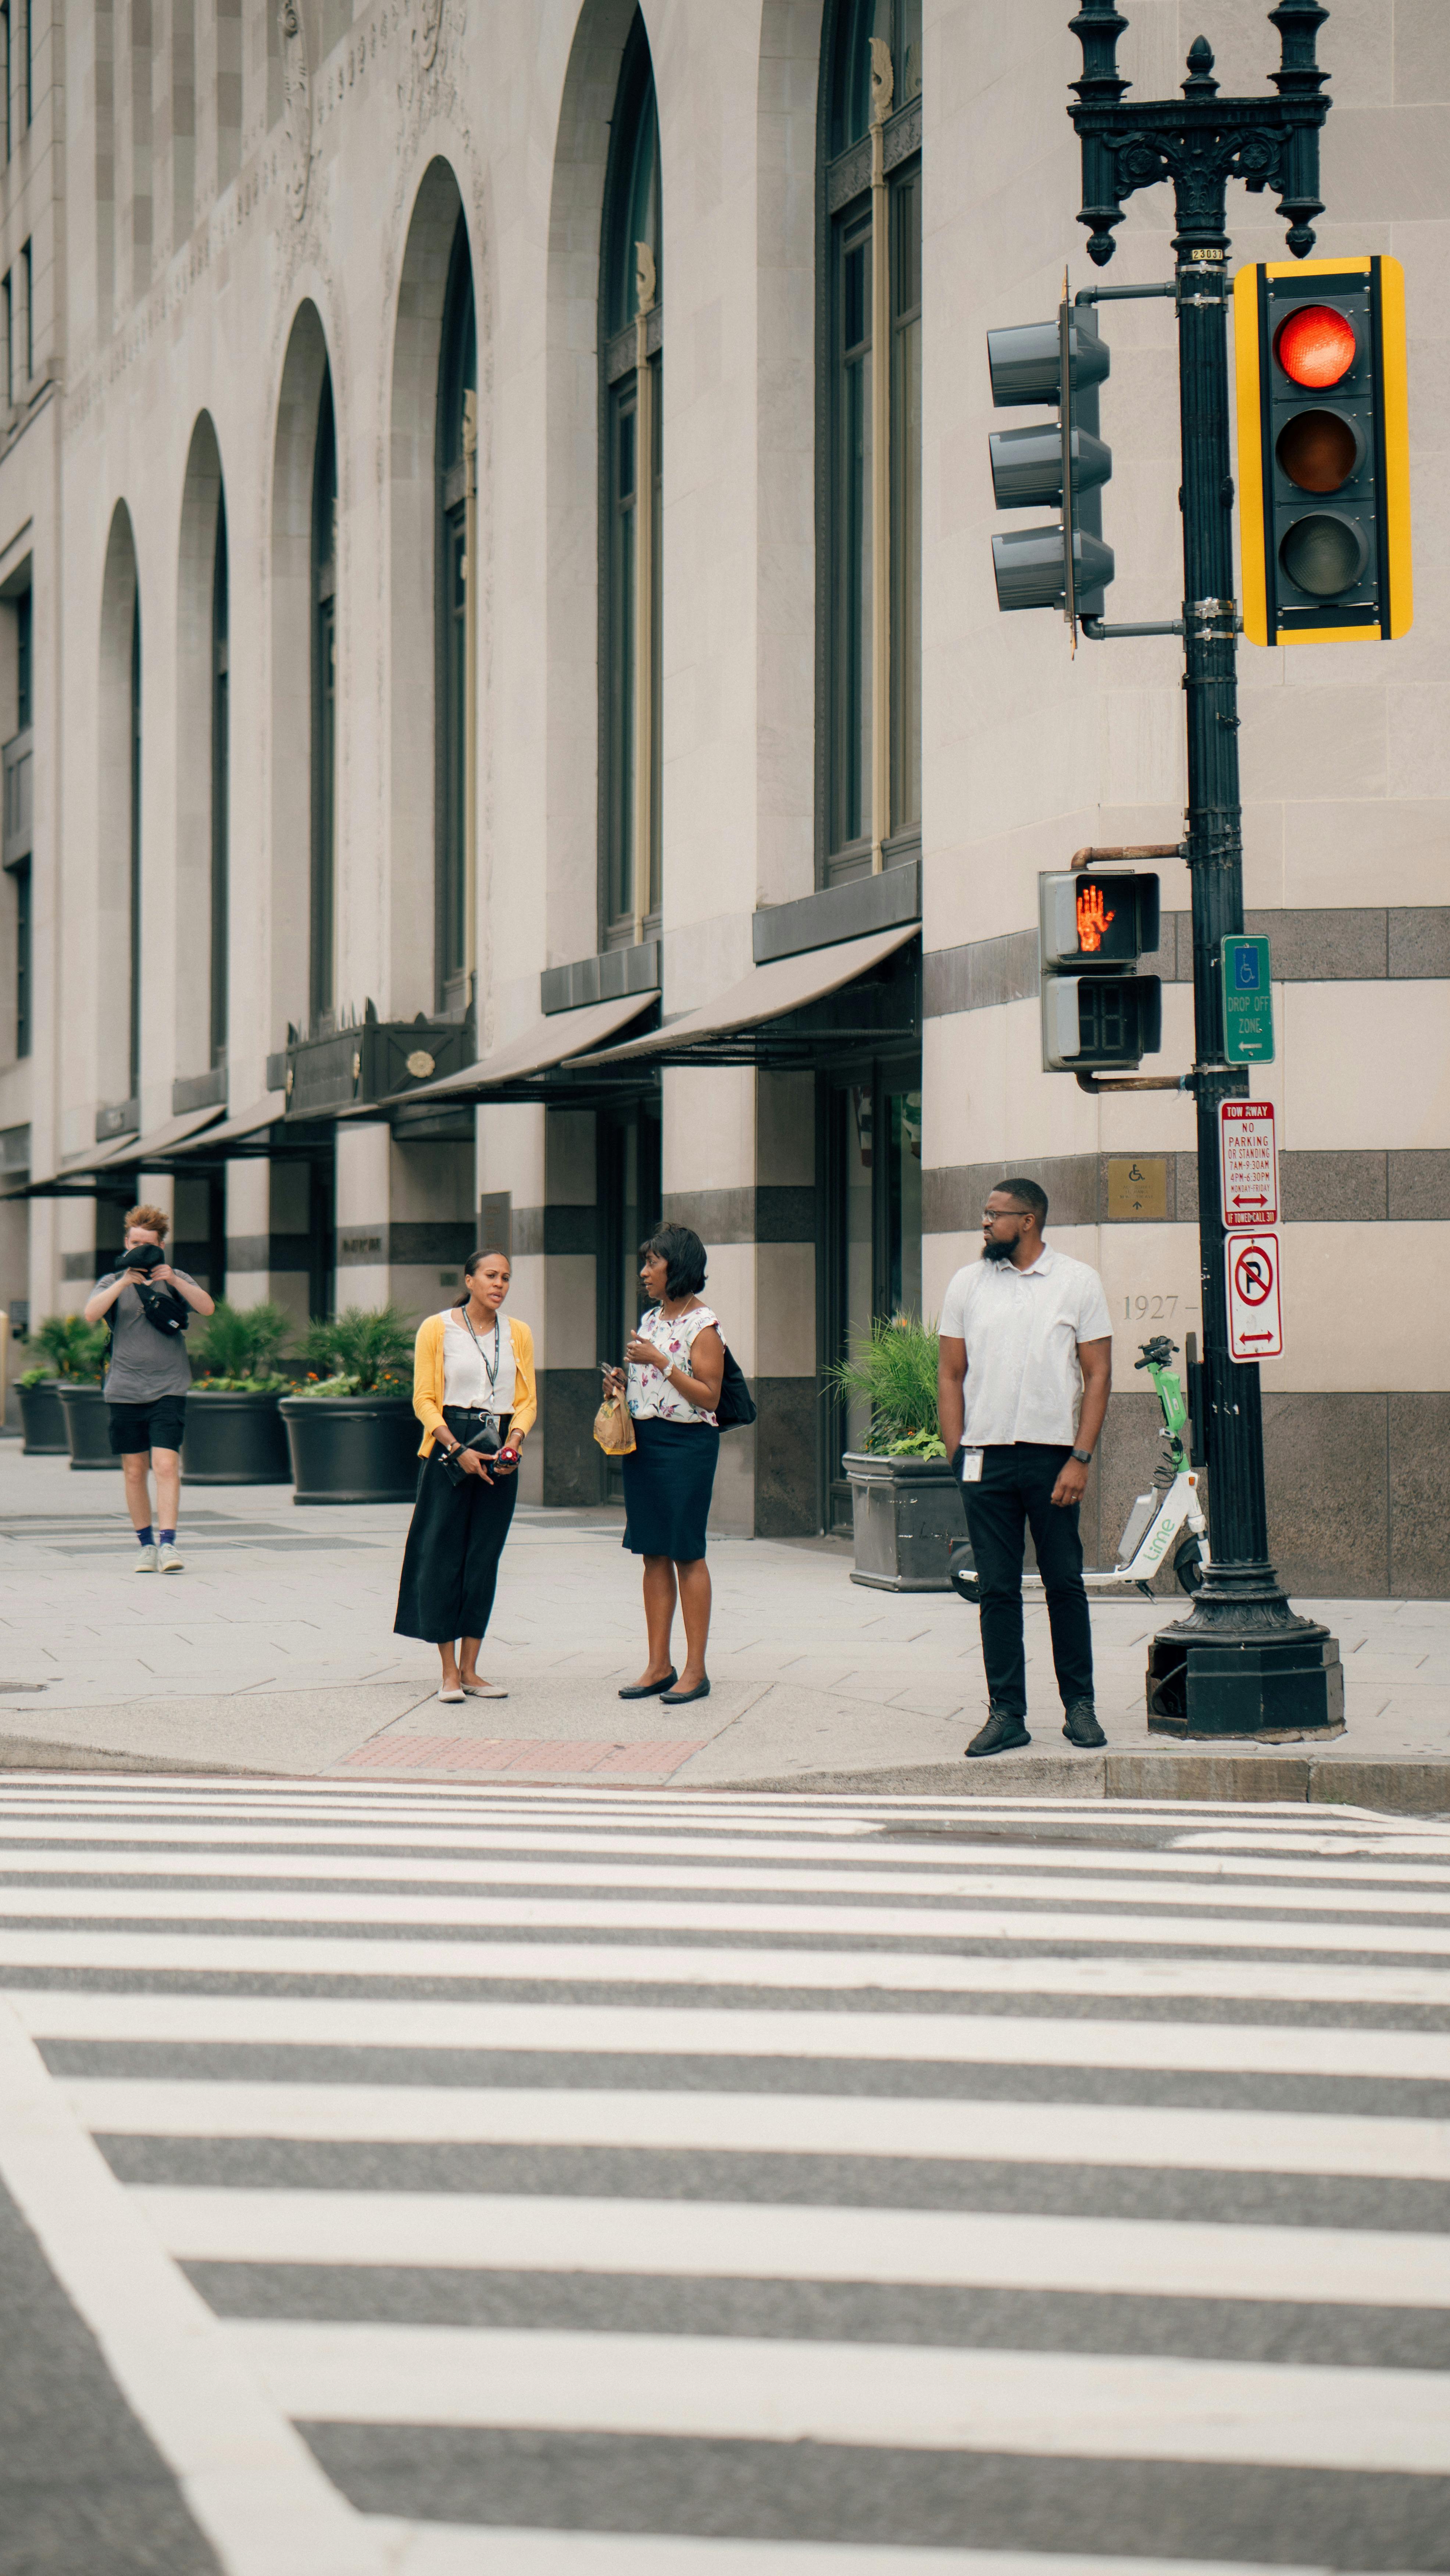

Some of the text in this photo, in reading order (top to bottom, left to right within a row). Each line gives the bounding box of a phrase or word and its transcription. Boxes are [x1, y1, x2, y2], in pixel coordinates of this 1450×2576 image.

[1194, 250, 1222, 259] 23037
[1228, 996, 1269, 1012] DROP OFF
[1239, 1018, 1261, 1034] ZONE
[1226, 1106, 1268, 1117] TOW AWAY
[1242, 1123, 1254, 1133] NO
[1229, 1136, 1268, 1147] PARKING
[1228, 1148, 1269, 1159] OR STANDING
[1229, 1161, 1269, 1170] 7AM-9:30AM
[1231, 1172, 1269, 1182] 4PM-6:30PM
[1231, 1184, 1270, 1193] MONDAY-FRIDAY
[1228, 1213, 1233, 1223] IF
[1234, 1213, 1250, 1223] TOWED
[1253, 1212, 1265, 1222] CALL
[1124, 1296, 1179, 1320] 1927
